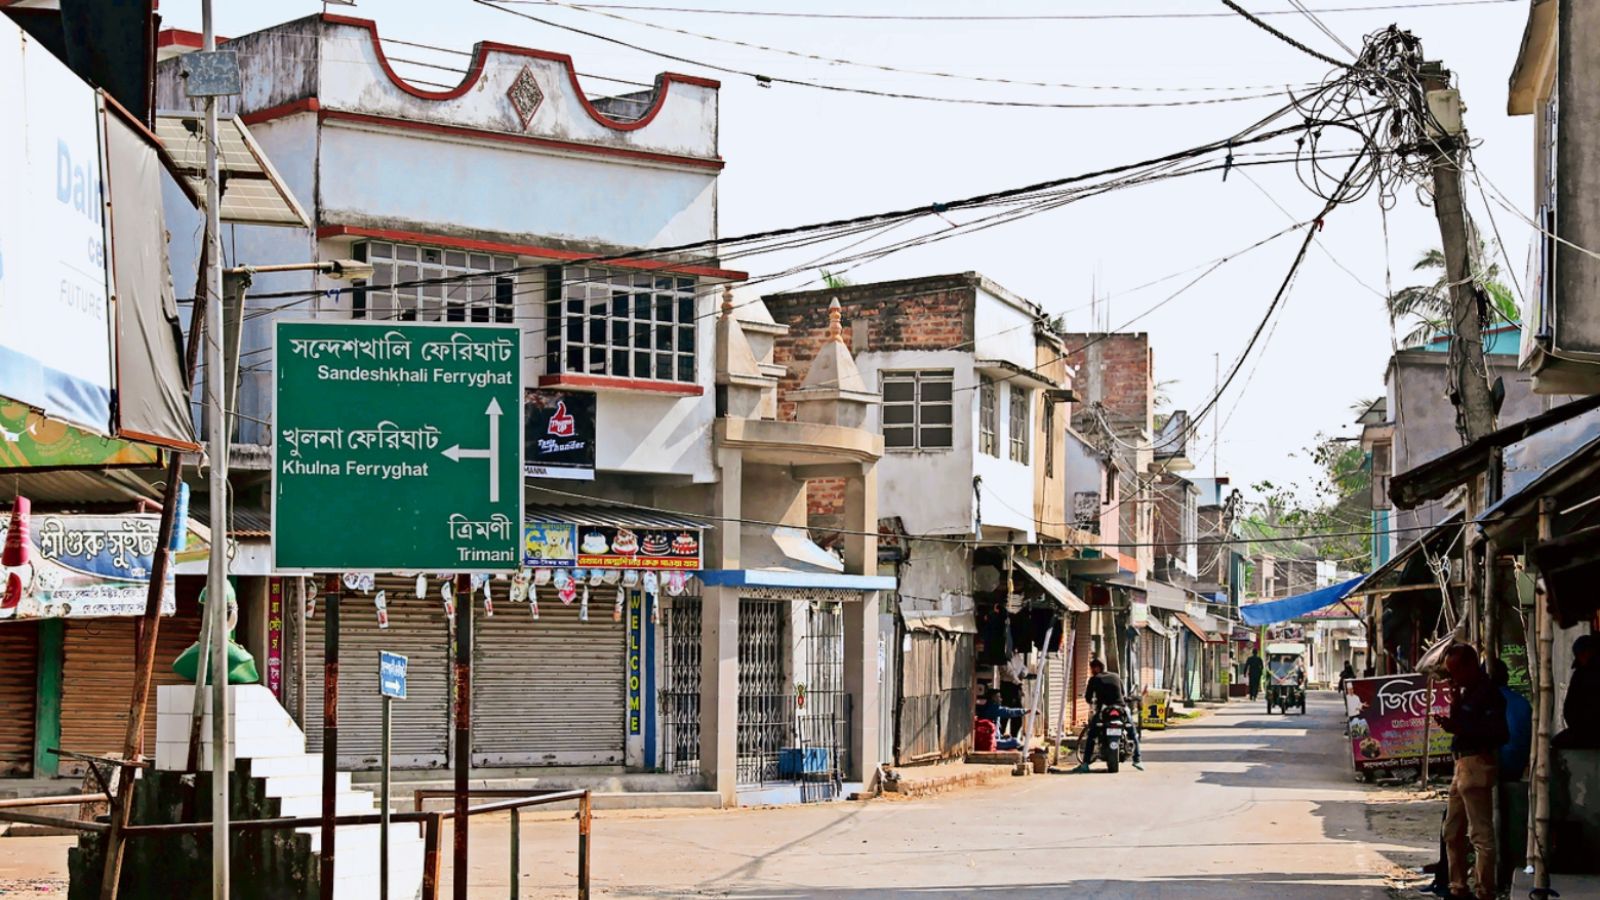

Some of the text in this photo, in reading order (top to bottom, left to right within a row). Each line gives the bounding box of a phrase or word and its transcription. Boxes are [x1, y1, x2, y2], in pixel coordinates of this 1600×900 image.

[59, 279, 101, 321] FUTURE
[289, 331, 514, 362] সন্দেশখালি ফেরিঘাট
[317, 365, 512, 387] Sandeshkhali Ferryghat
[282, 420, 441, 458] খুলনা ফেরিঘাট
[282, 460, 429, 479] Khulna Ferryghat
[456, 547, 515, 562] Trimani
[630, 595, 640, 731] WELCOME
[1148, 704, 1159, 718] 1
